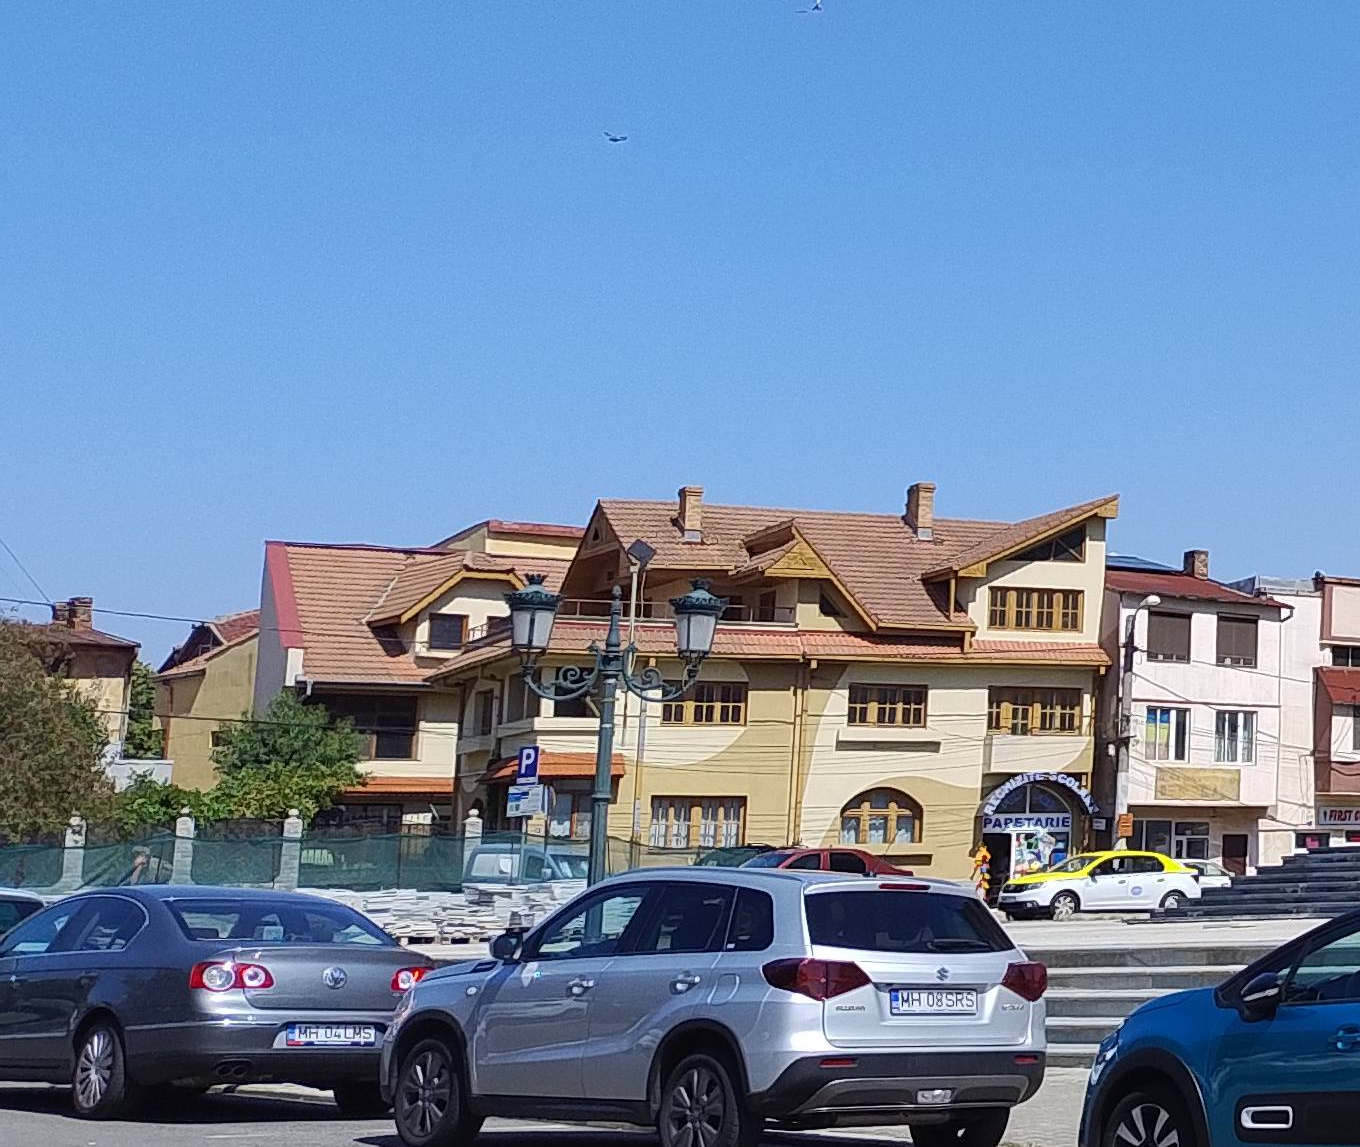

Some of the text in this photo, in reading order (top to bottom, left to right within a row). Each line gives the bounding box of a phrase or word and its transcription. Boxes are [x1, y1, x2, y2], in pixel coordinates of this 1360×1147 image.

[521, 748, 535, 774] P
[983, 816, 1071, 830] PAPETARIE
[1329, 809, 1353, 822] FIRST
[900, 990, 921, 1008] MH
